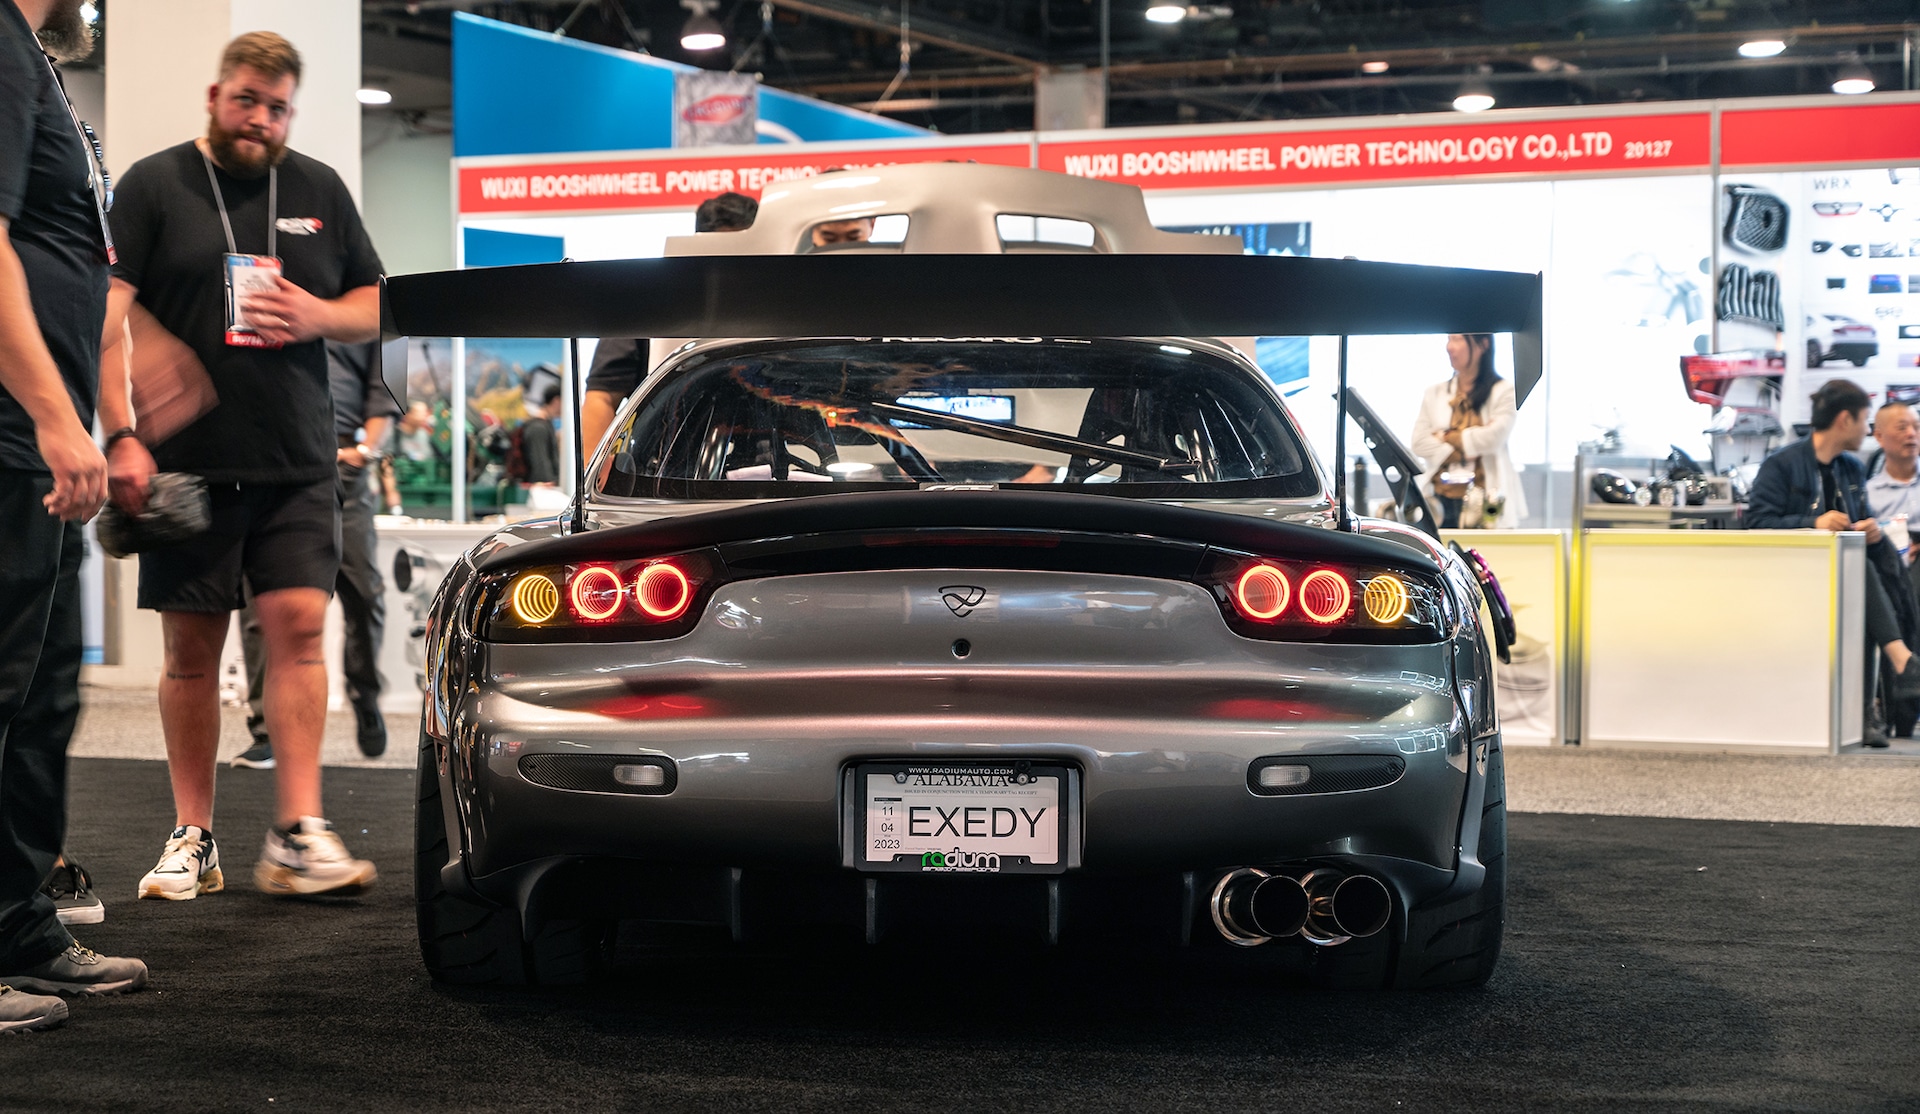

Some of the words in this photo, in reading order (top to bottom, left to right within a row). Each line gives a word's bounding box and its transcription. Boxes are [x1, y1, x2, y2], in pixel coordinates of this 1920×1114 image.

[1064, 153, 1118, 178] WUXI
[1122, 147, 1276, 176] BOOSHIWHEEL
[1280, 143, 1361, 169] POWER
[1366, 136, 1518, 166] TECHNOLOGY
[1523, 131, 1613, 161] CO.,LTD
[1624, 140, 1673, 159] 20127
[480, 176, 528, 199] WUXI
[530, 170, 662, 198] BOOSHIWHEEL
[666, 168, 735, 193] POWER
[1813, 176, 1852, 190] WRX
[908, 767, 1014, 775] WWW.RADIUMAUTO.COM
[913, 775, 1008, 787] ALABAMA
[882, 806, 893, 816] 11
[881, 822, 894, 832] 04
[909, 806, 1047, 838] EXEDY
[874, 839, 900, 849] 2023
[921, 847, 1000, 867] radium
